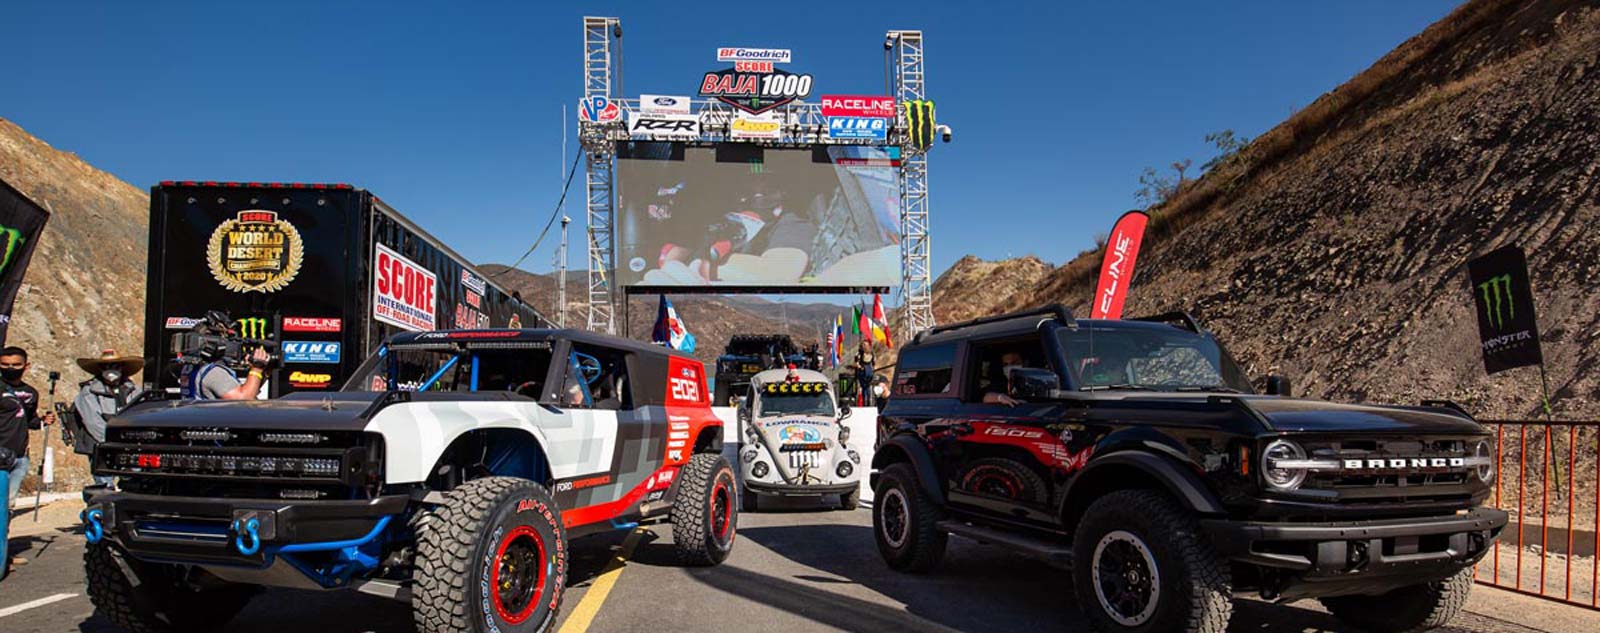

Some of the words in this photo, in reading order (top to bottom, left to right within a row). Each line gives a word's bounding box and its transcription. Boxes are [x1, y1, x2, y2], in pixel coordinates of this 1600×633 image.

[720, 48, 789, 59] BFGoodrich
[735, 61, 773, 73] SCORE
[701, 73, 757, 95] BAJA
[761, 74, 812, 96] 1000
[583, 97, 607, 122] VP
[822, 99, 894, 110] RACELINE
[631, 118, 697, 132] RZR
[831, 118, 884, 130] KING
[242, 213, 273, 222] SCORE
[228, 231, 284, 245] WORLD
[227, 247, 284, 259] DESERT
[242, 272, 266, 281] 2020
[1100, 230, 1130, 319] ELINE
[377, 252, 435, 314] SCORE
[376, 304, 411, 323] OFF-ROAD
[377, 295, 433, 322] INTERNATIONAL
[284, 318, 341, 327] RACELINE
[285, 343, 338, 353] KING
[670, 377, 700, 402] 2021
[766, 419, 831, 427] LOWRANCE
[1344, 457, 1464, 469] BRONCO
[556, 482, 572, 492] FORD
